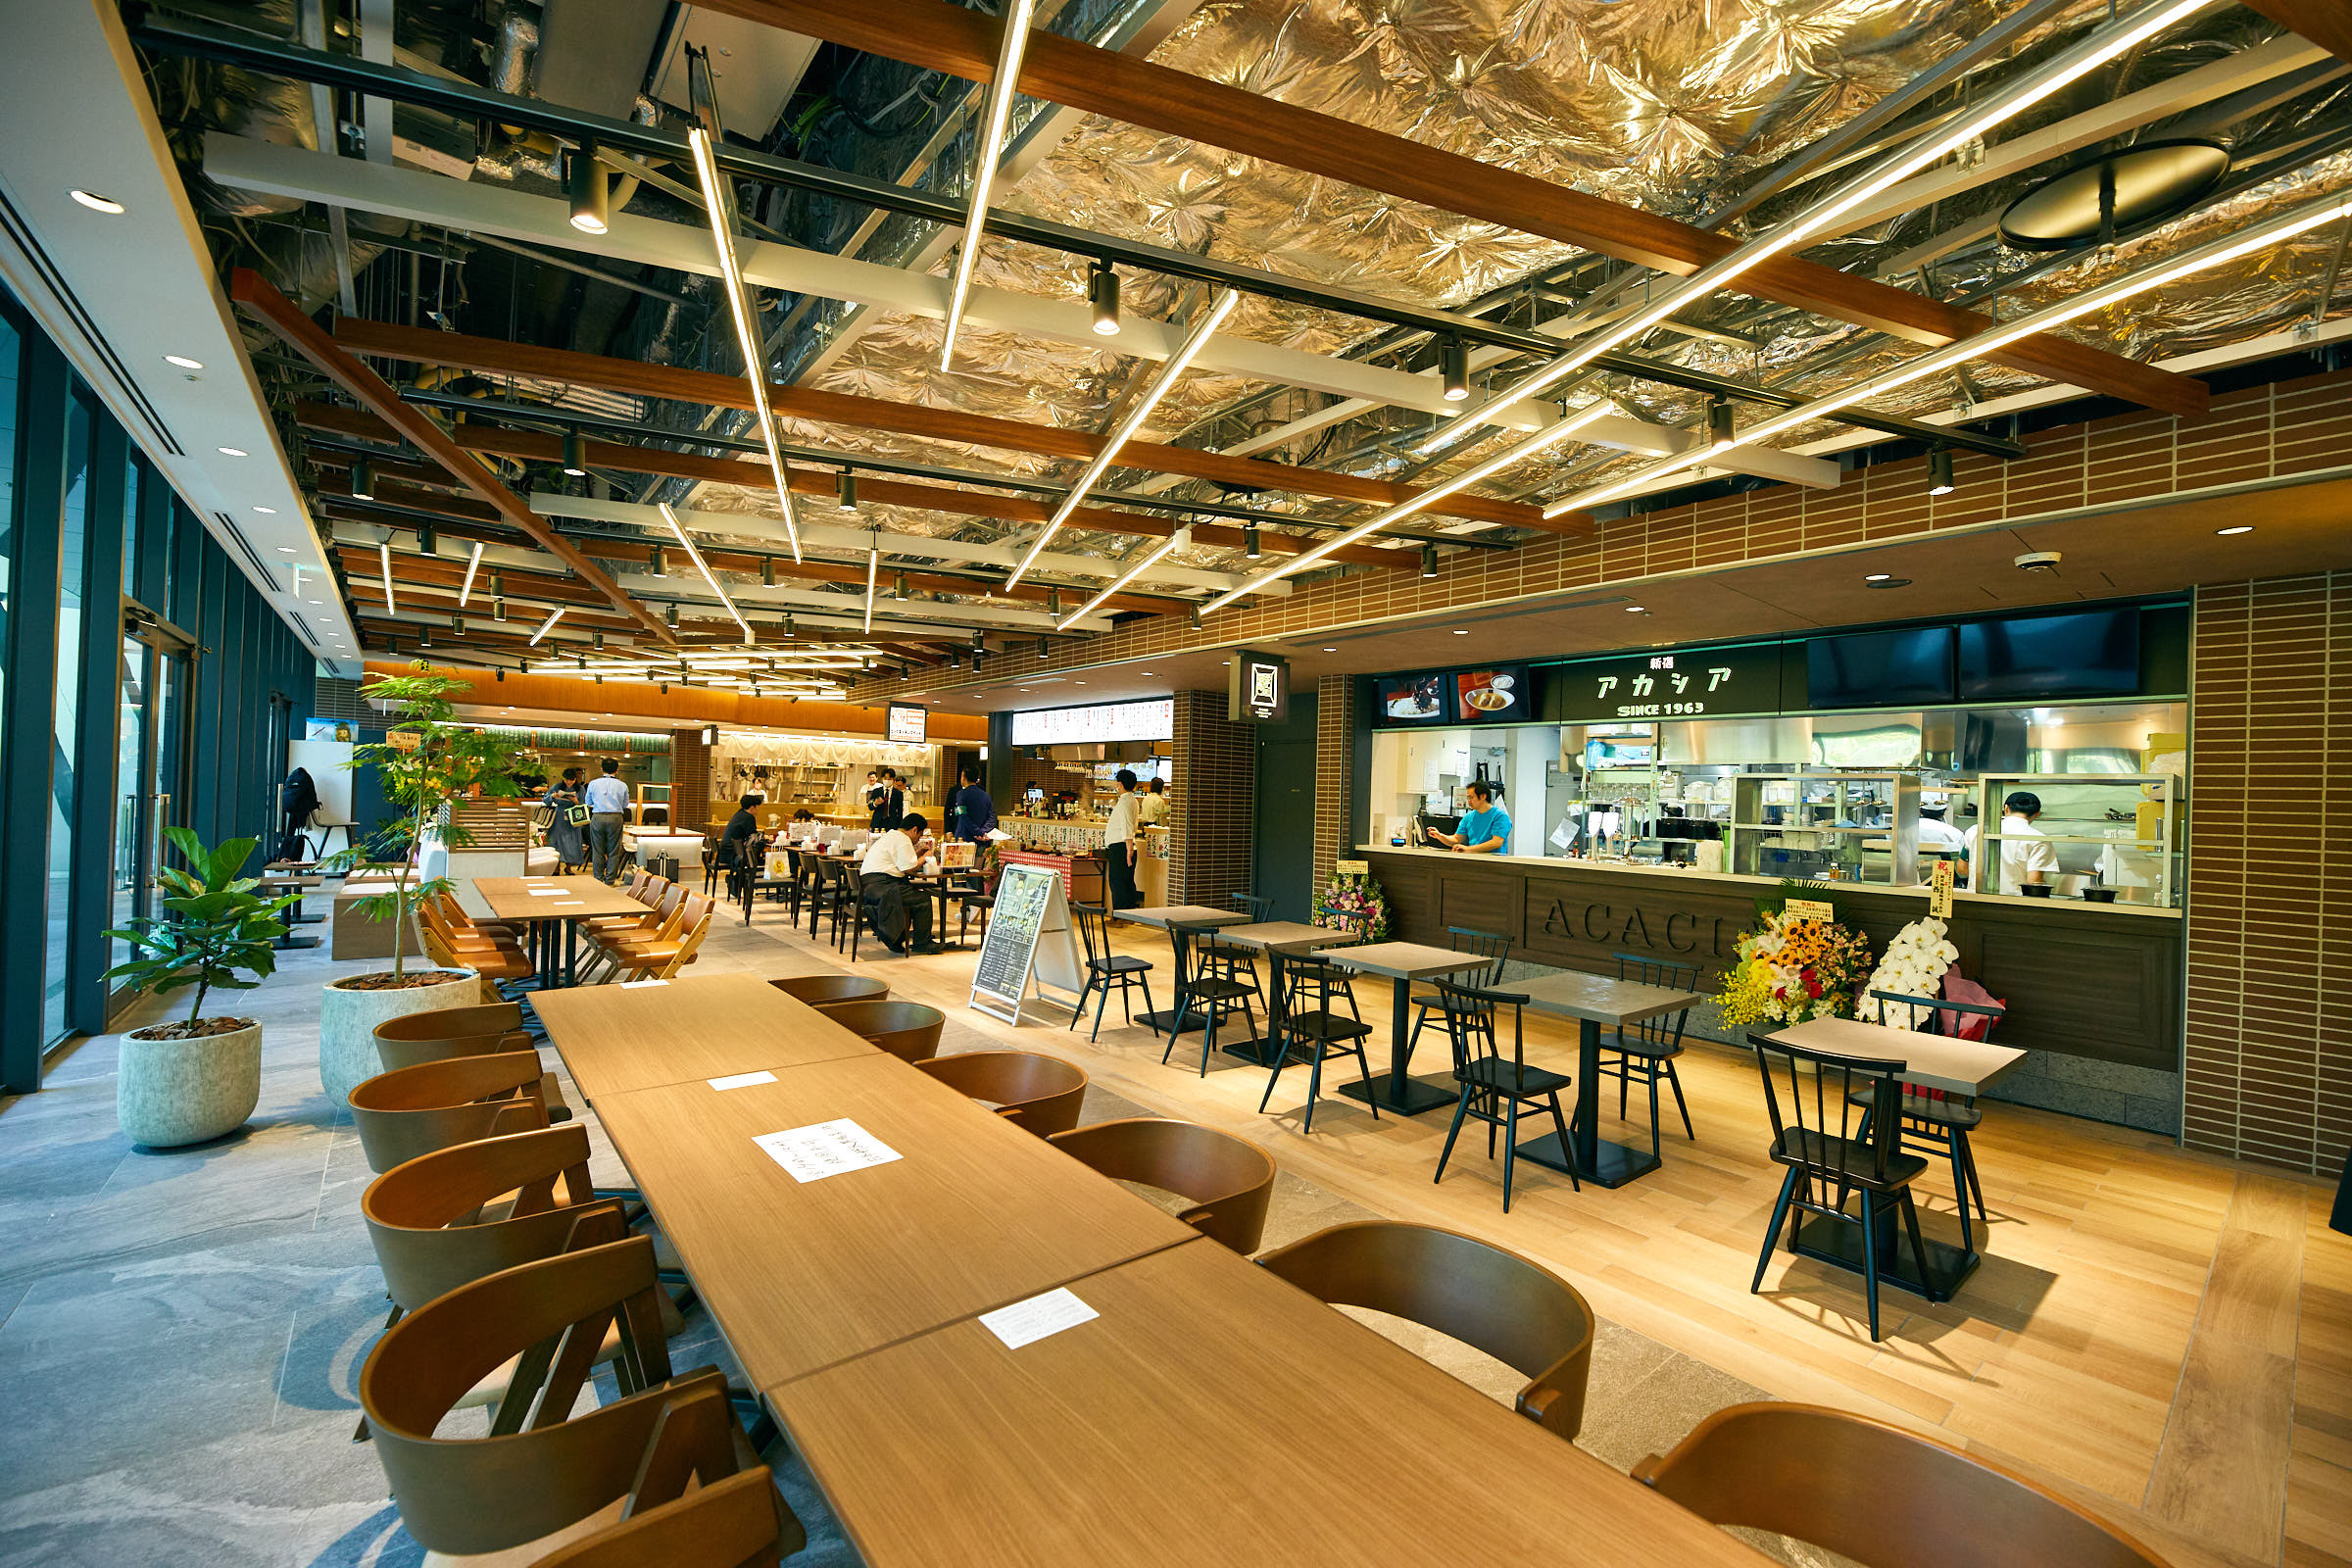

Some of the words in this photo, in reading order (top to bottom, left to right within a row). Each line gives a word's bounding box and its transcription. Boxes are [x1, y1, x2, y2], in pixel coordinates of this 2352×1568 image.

[1649, 656, 1674, 670] 新宿
[1597, 666, 1732, 699] アカシア
[1617, 704, 1660, 716] SINCE
[1664, 702, 1704, 714] 1963
[1544, 899, 1758, 957] ACACI
